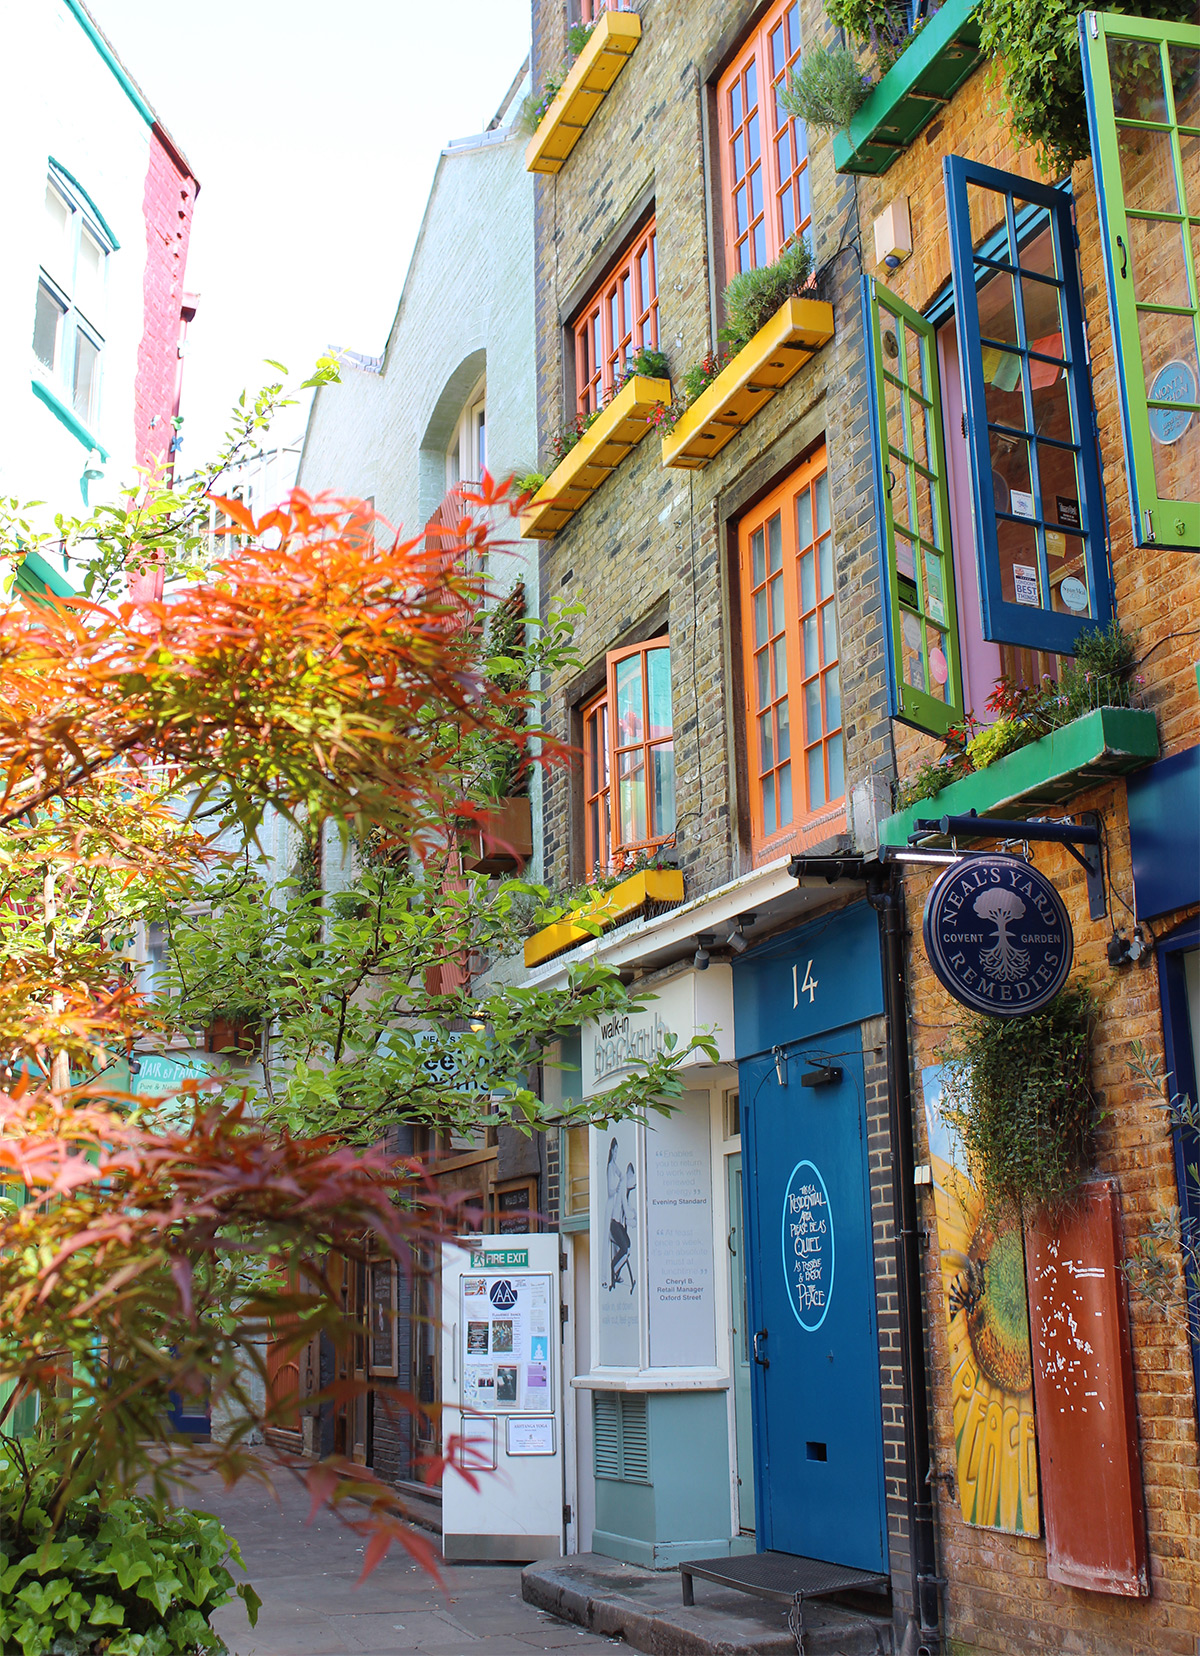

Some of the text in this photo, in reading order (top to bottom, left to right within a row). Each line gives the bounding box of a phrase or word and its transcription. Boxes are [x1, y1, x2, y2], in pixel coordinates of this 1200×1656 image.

[1017, 584, 1037, 596] BEST
[1017, 593, 1038, 601] THINGS
[942, 867, 1058, 926] NEAL'S YARD
[943, 933, 1061, 944] COVENT GARDEN
[792, 958, 819, 1009] 14
[949, 951, 1059, 1001] REMEDIES
[601, 1014, 630, 1041] walk-in
[594, 1012, 668, 1077] backrub
[139, 1059, 162, 1079] HAIR
[172, 1063, 202, 1081] FAIRY
[652, 1197, 707, 1206] Evening Standard
[787, 1191, 827, 1214] RESIDENTIAL
[790, 1219, 827, 1238] PLEASE BE AS
[794, 1236, 822, 1259] QUIET
[486, 1252, 527, 1265] FIRE EXIT
[793, 1258, 822, 1272] AS POSSIBLE
[665, 1278, 687, 1286] Cheryl
[805, 1267, 823, 1281] ENJOY
[676, 1286, 704, 1294] Manager
[795, 1283, 826, 1312] PEACE
